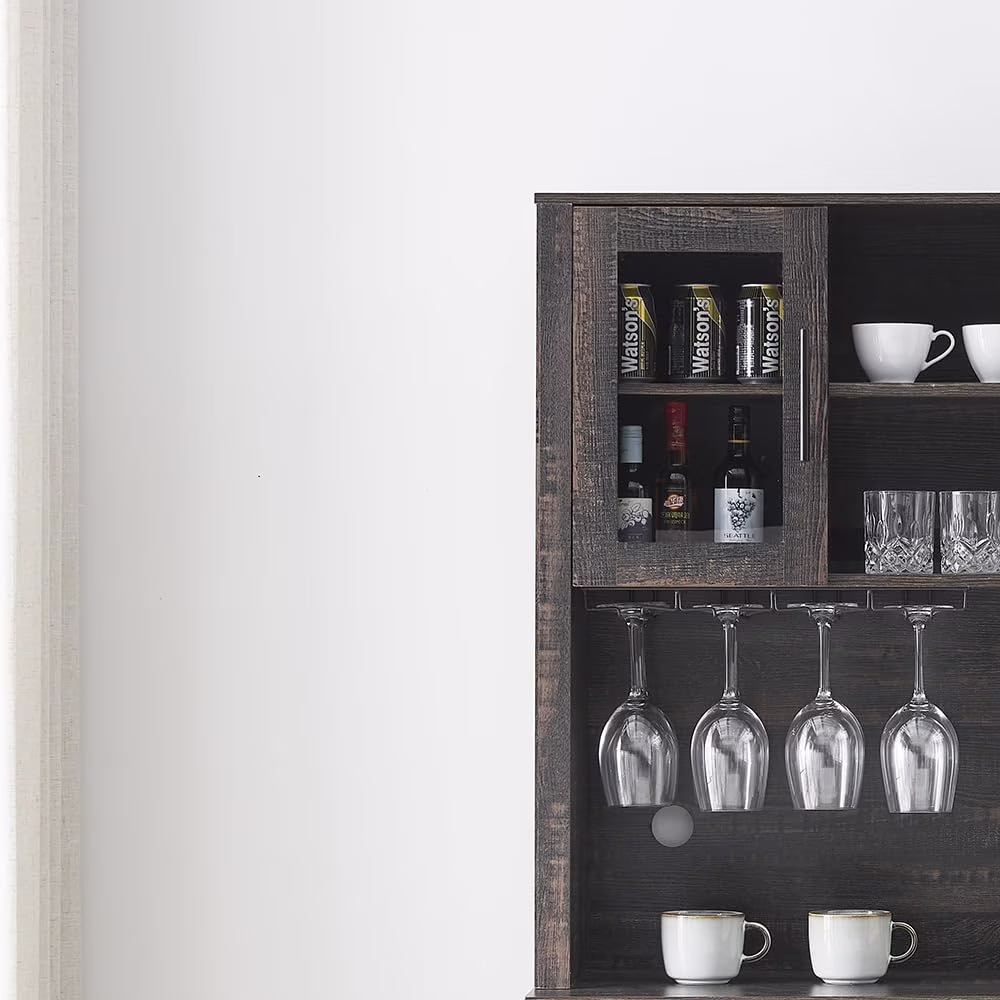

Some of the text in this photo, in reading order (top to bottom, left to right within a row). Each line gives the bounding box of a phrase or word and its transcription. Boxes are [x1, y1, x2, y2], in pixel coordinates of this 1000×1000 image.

[621, 298, 638, 374] Watson's
[692, 298, 710, 374] Watson's
[762, 298, 779, 374] Watson's
